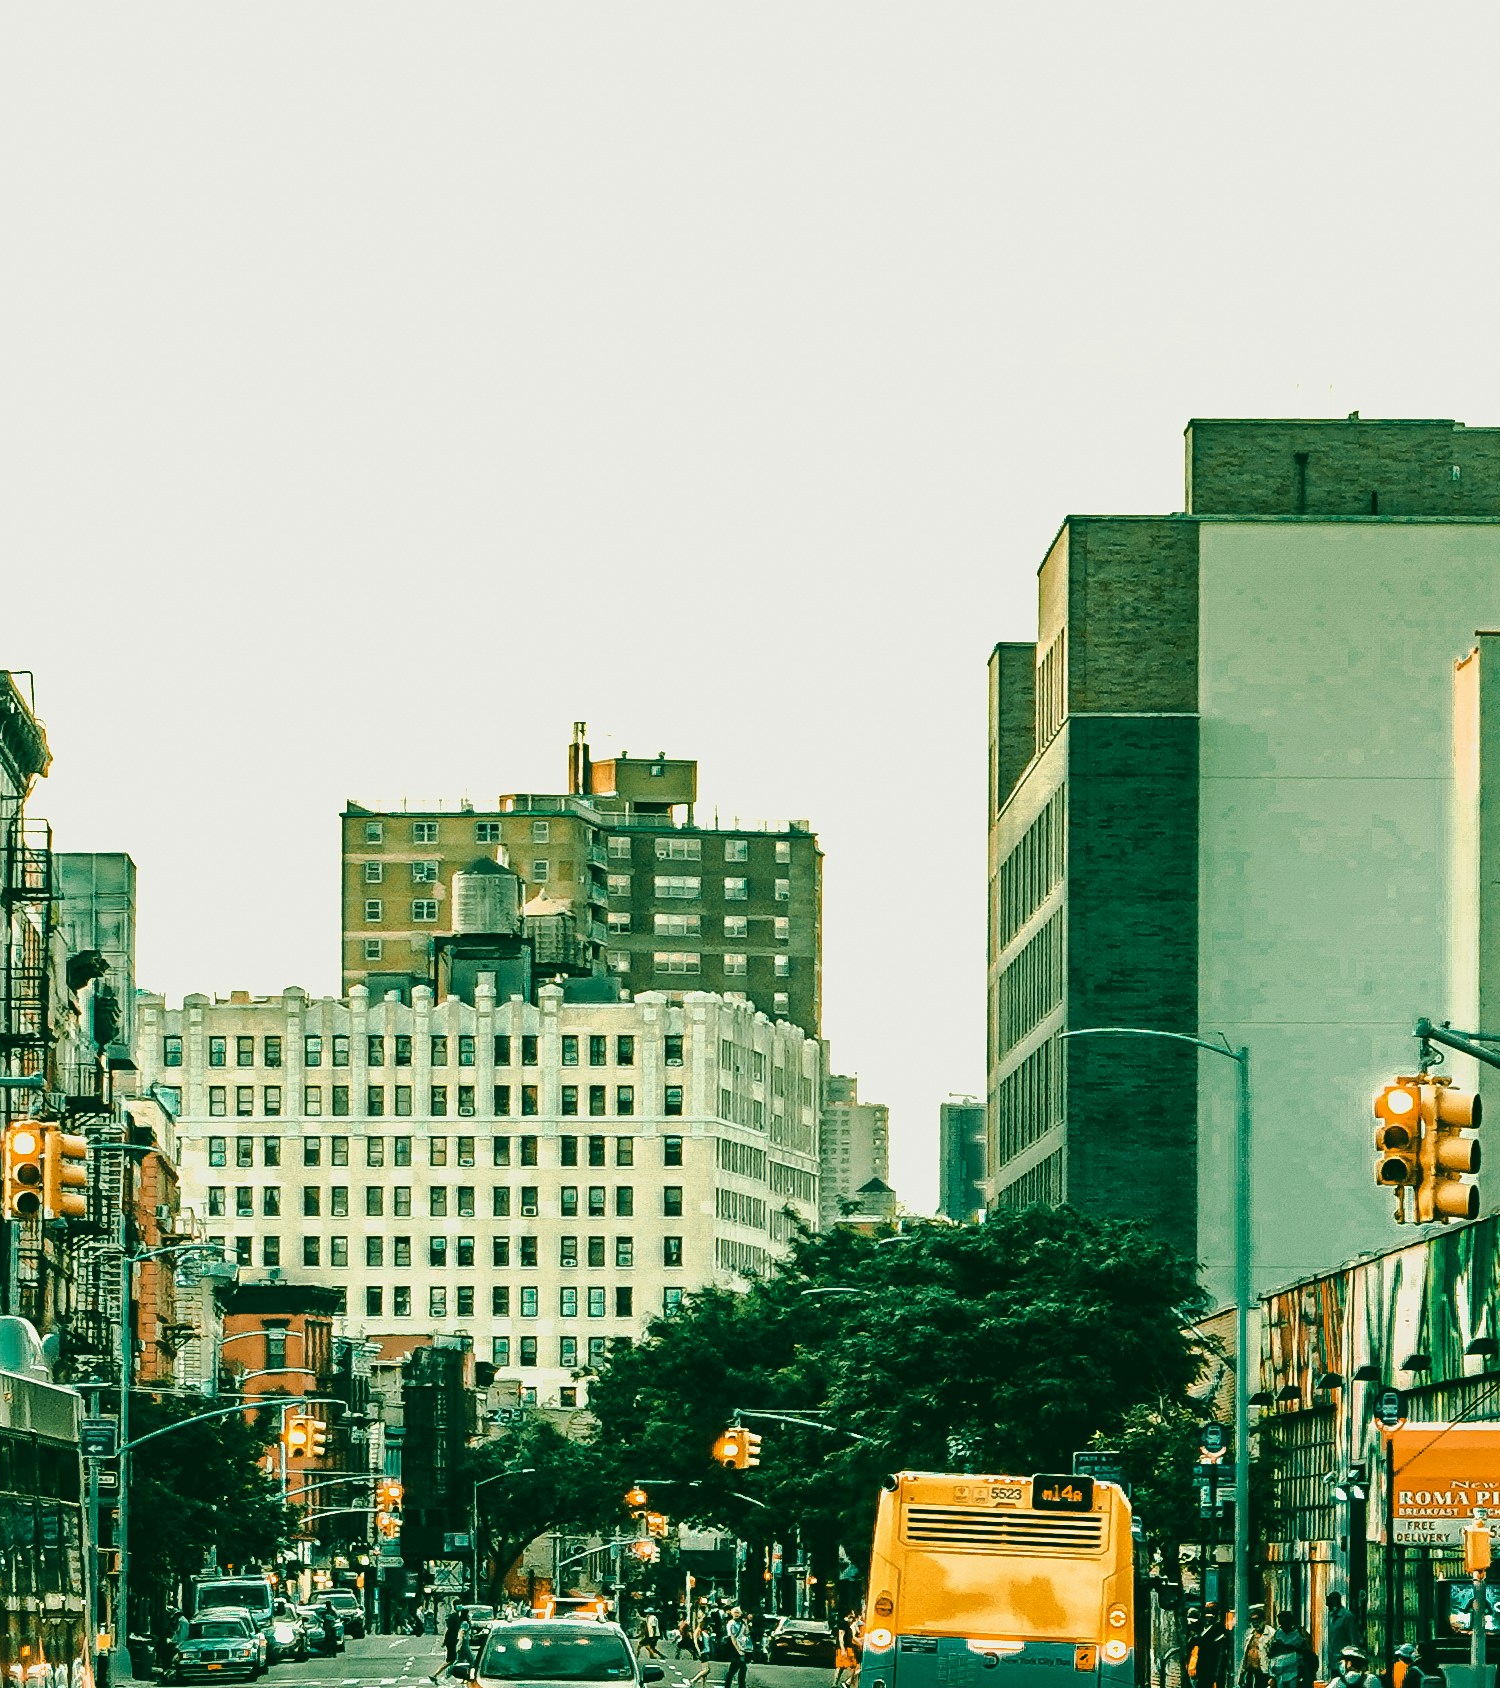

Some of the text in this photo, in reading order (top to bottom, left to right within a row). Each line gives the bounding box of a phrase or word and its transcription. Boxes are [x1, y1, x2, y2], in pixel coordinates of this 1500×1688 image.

[1450, 1480, 1500, 1489] New
[990, 1487, 1023, 1500] 5523
[1398, 1491, 1470, 1505] ROMA
[1398, 1507, 1459, 1516] BREAKFAST
[1466, 1507, 1500, 1517] LCH
[1407, 1520, 1436, 1531] FREE
[1396, 1532, 1451, 1543] DELIVERY
